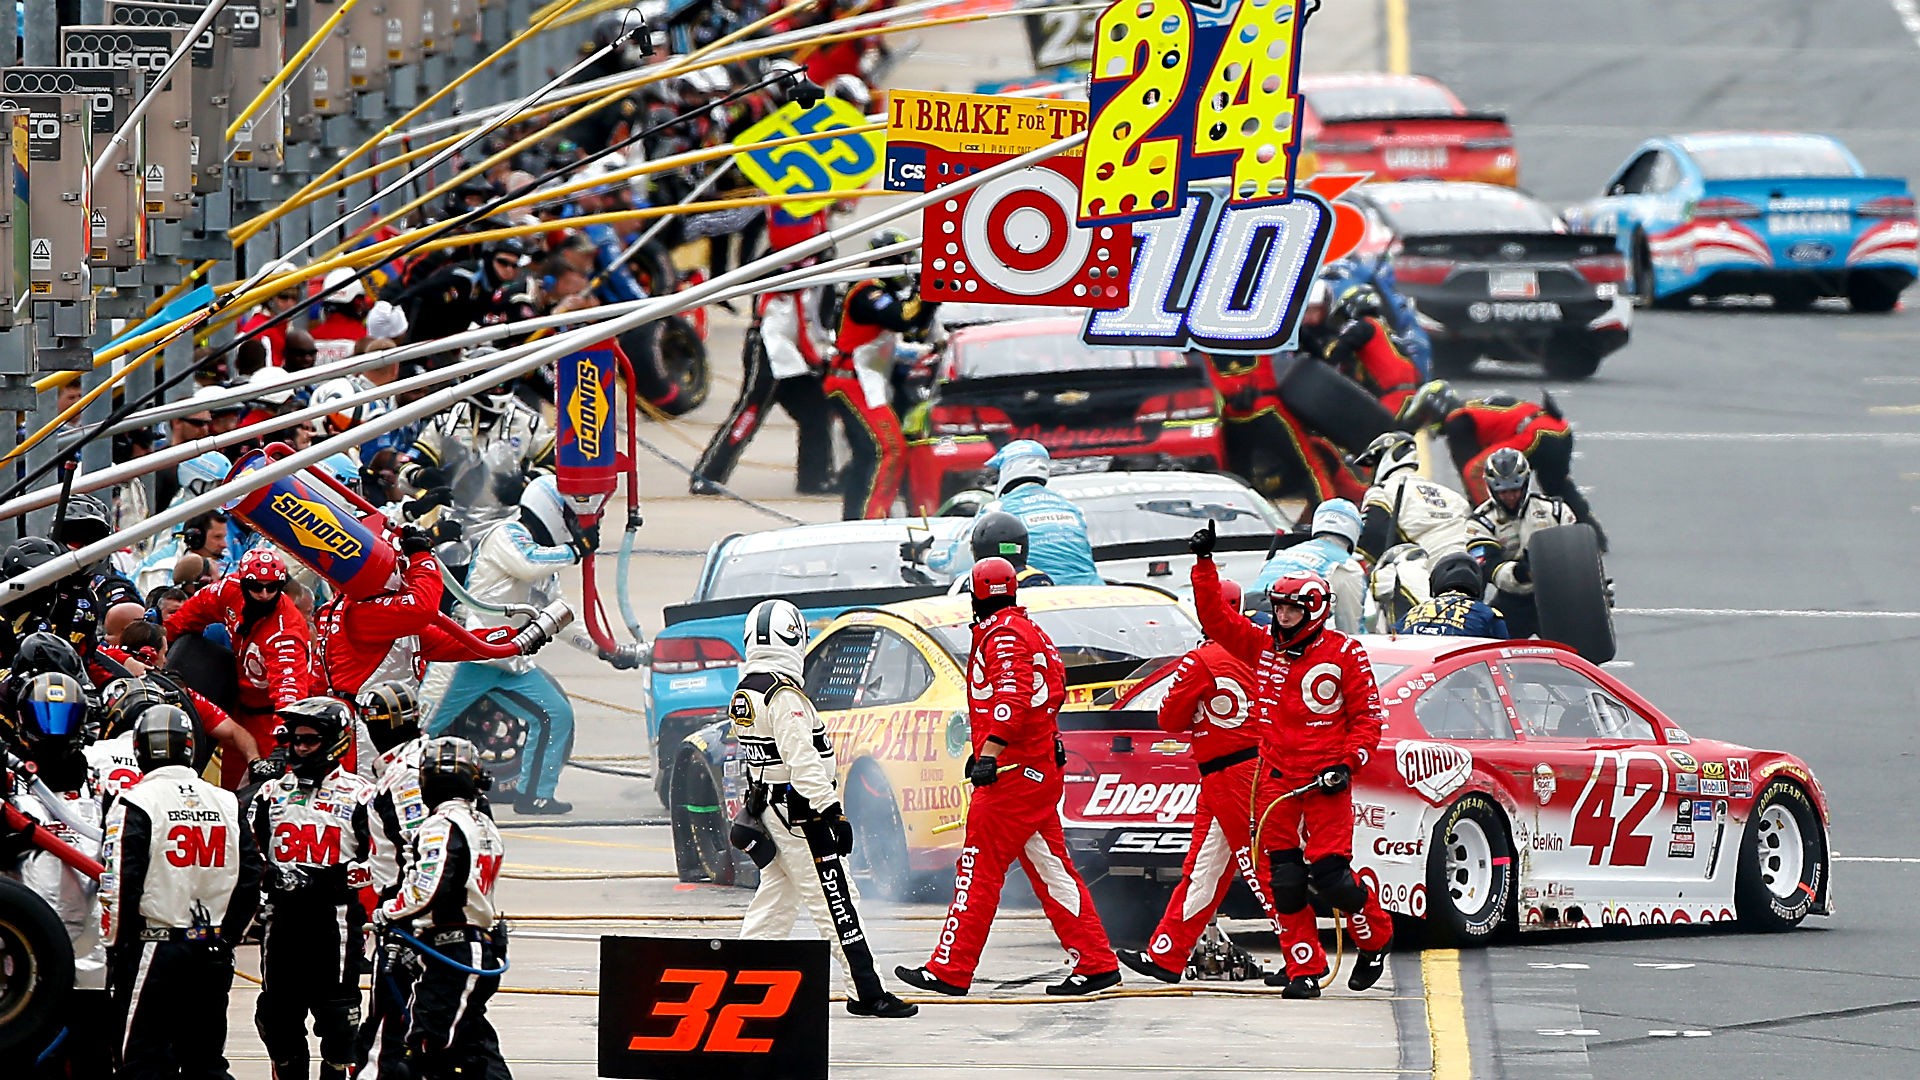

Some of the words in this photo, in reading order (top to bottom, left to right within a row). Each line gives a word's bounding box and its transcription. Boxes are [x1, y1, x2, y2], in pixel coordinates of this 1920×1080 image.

[66, 52, 171, 71] MUSCO
[915, 98, 1012, 136] BRAKE
[1017, 113, 1046, 131] FOR
[1080, 0, 1296, 219] 24
[749, 103, 876, 196] 55
[1088, 196, 1322, 340] 10
[1492, 302, 1563, 320] TOYOTA
[580, 363, 597, 455] SUNOCO
[274, 496, 361, 558] SUNOCO
[875, 709, 944, 762] SAFE
[1405, 748, 1464, 785] CLOROX
[1730, 759, 1748, 780] 3M
[312, 801, 334, 813] 3M
[1569, 750, 1669, 868] 42
[1758, 782, 1801, 817] GOODYEAR
[1108, 832, 1193, 853] SS
[1443, 797, 1484, 846] GOODYEAR
[1532, 833, 1563, 851] belkin
[165, 825, 227, 868] 3M
[274, 822, 342, 866] 3M
[1373, 836, 1424, 856] Crest
[822, 868, 850, 925] Sprint
[934, 846, 980, 965] target.com
[843, 928, 859, 939] CUP
[627, 968, 802, 1053] 32
